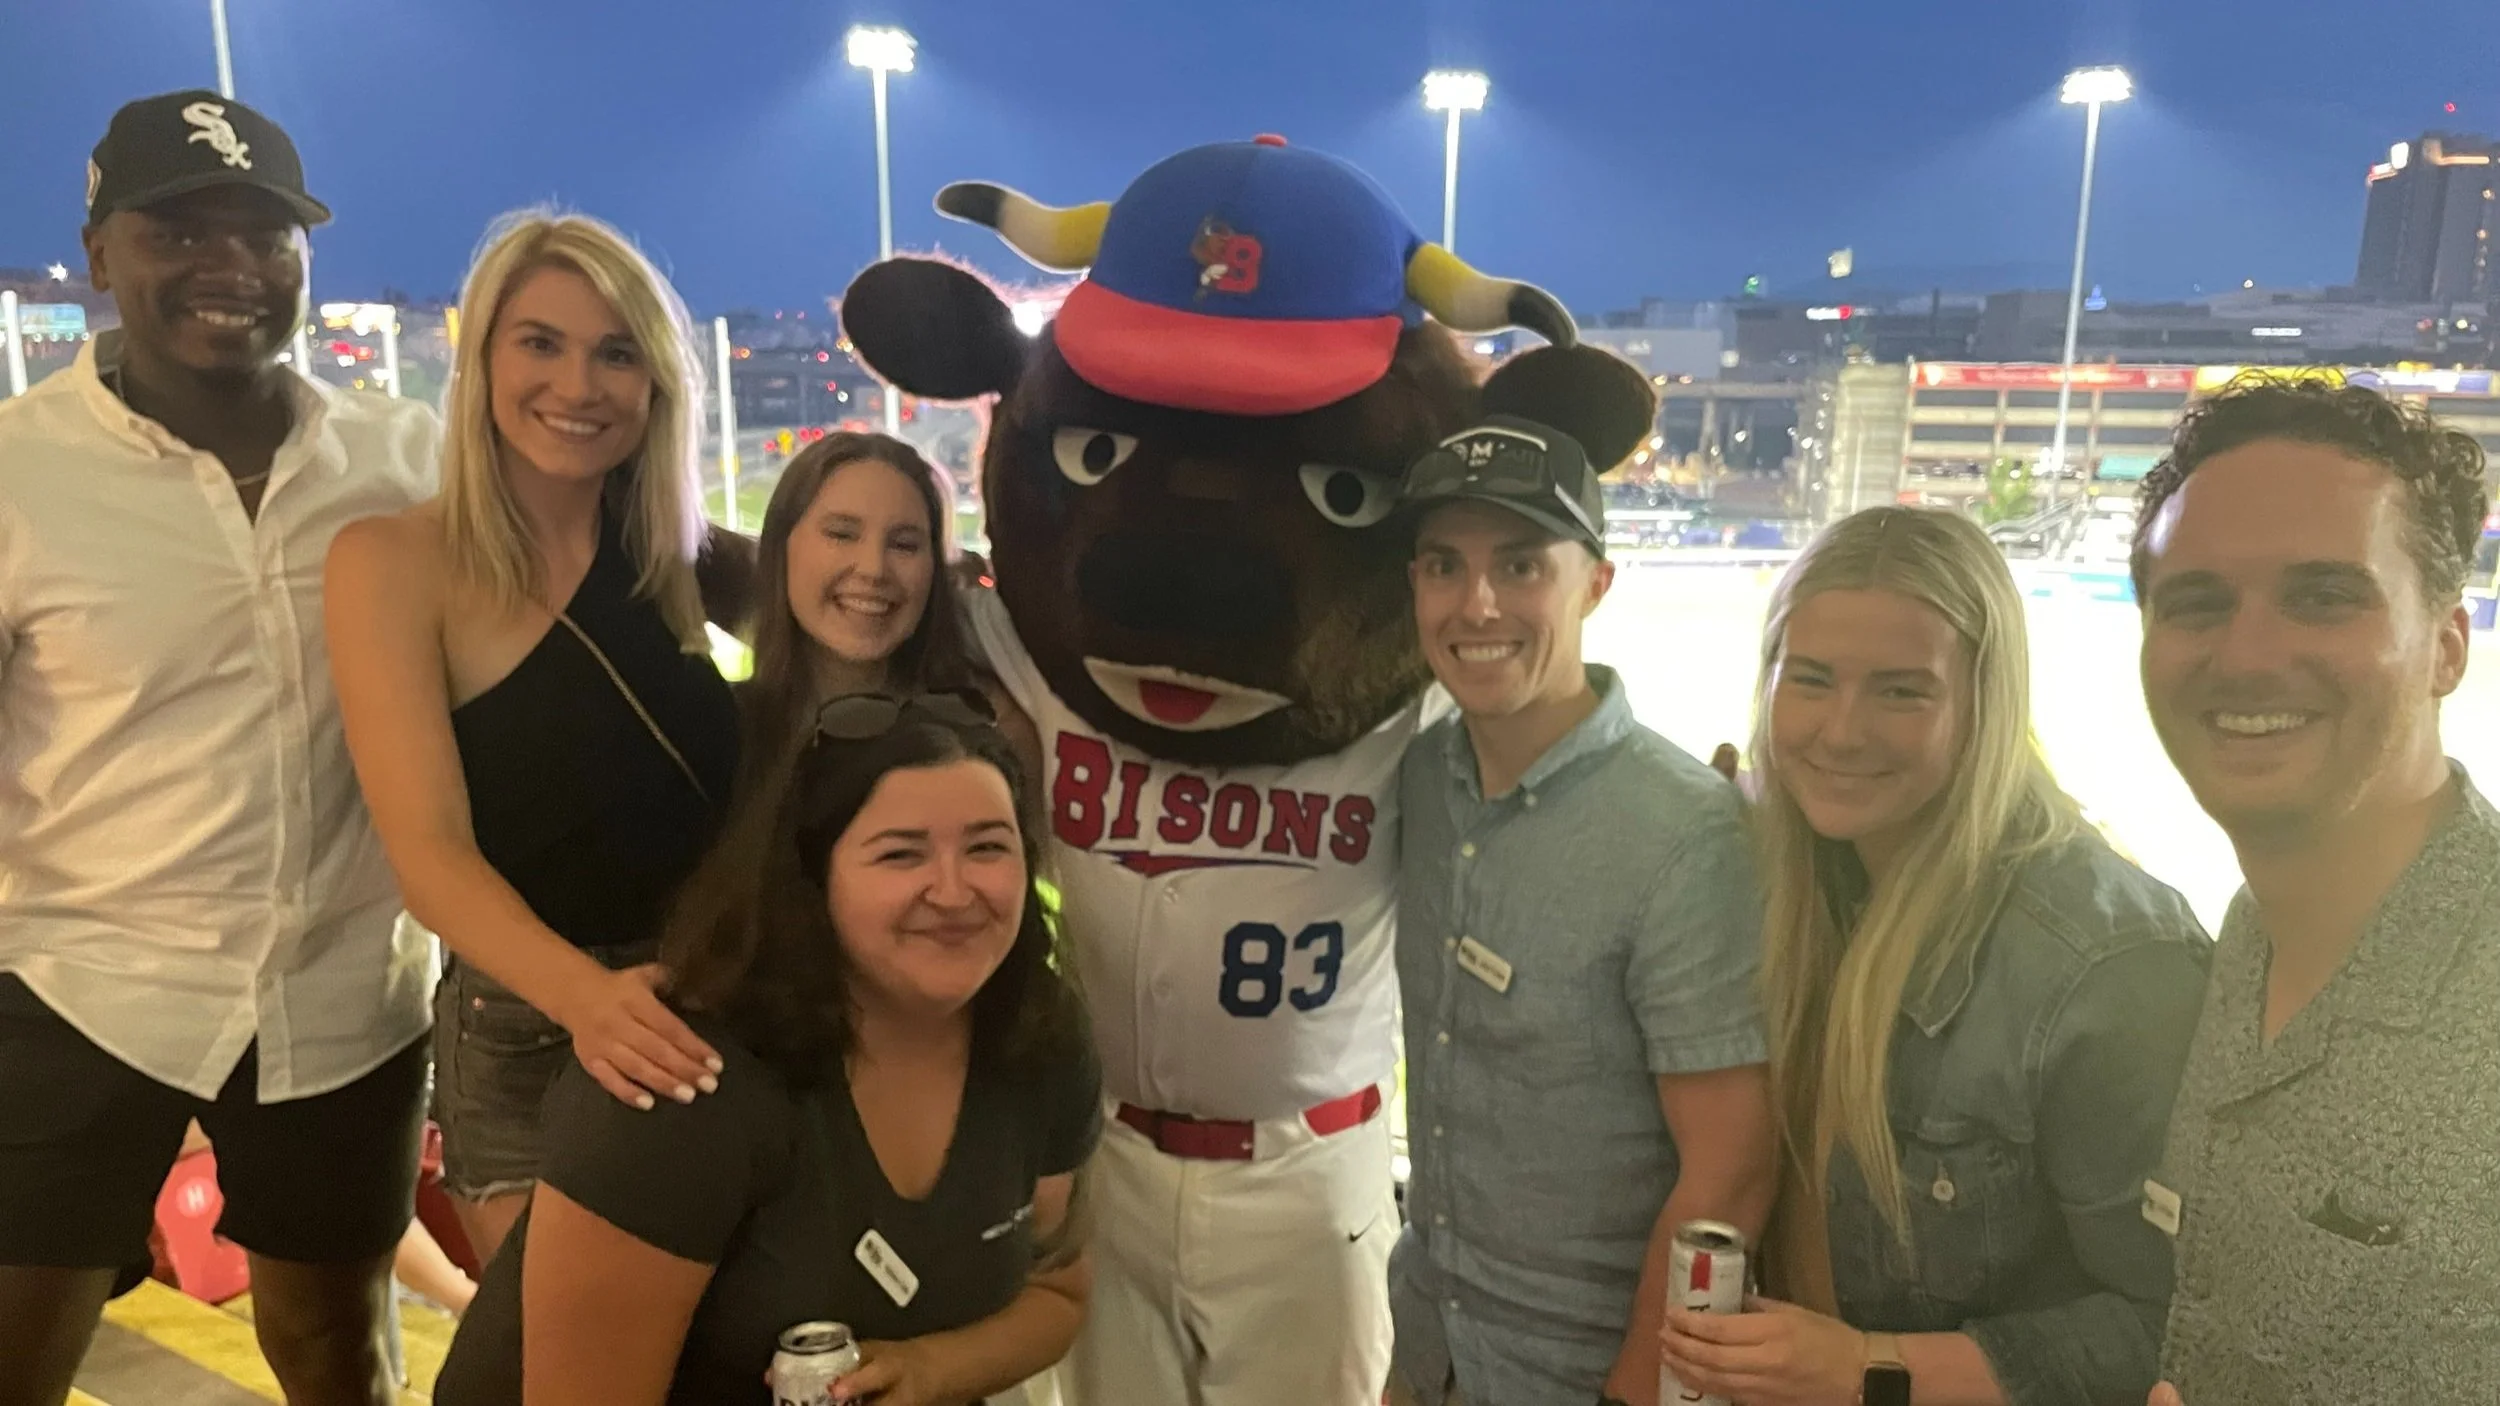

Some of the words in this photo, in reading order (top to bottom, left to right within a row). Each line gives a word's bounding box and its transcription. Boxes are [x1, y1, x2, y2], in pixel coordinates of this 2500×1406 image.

[182, 101, 252, 170] Sox
[1053, 730, 1376, 865] BISONS
[1218, 920, 1344, 1019] 83
